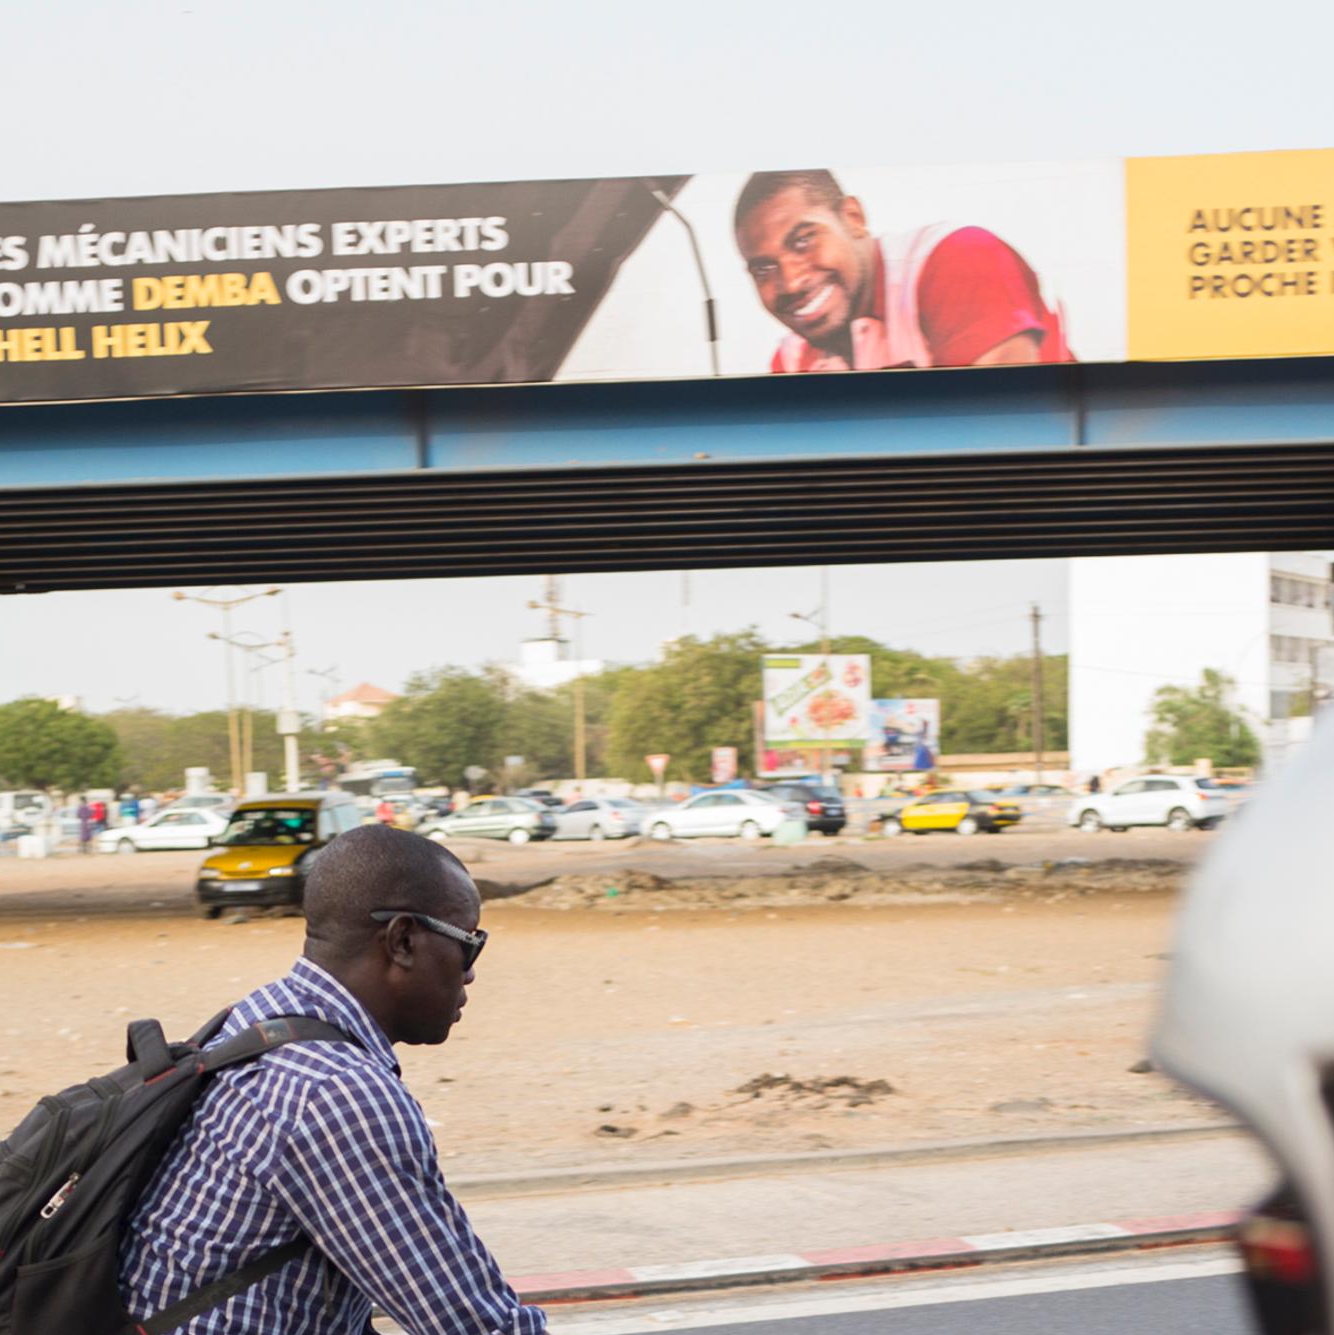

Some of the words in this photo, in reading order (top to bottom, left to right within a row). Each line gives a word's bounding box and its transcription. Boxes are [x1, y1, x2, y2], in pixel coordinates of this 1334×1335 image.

[1189, 205, 1322, 233] AUCUNE
[37, 223, 323, 268] MÉCANICIENS
[332, 217, 508, 255] EXPERTS
[1189, 238, 1318, 266] GARDER
[133, 272, 281, 310] DEMBA
[286, 265, 447, 304] OPTENT
[455, 261, 575, 297] POUR
[1190, 271, 1316, 298] PROCHE
[92, 321, 213, 358] HELIX
